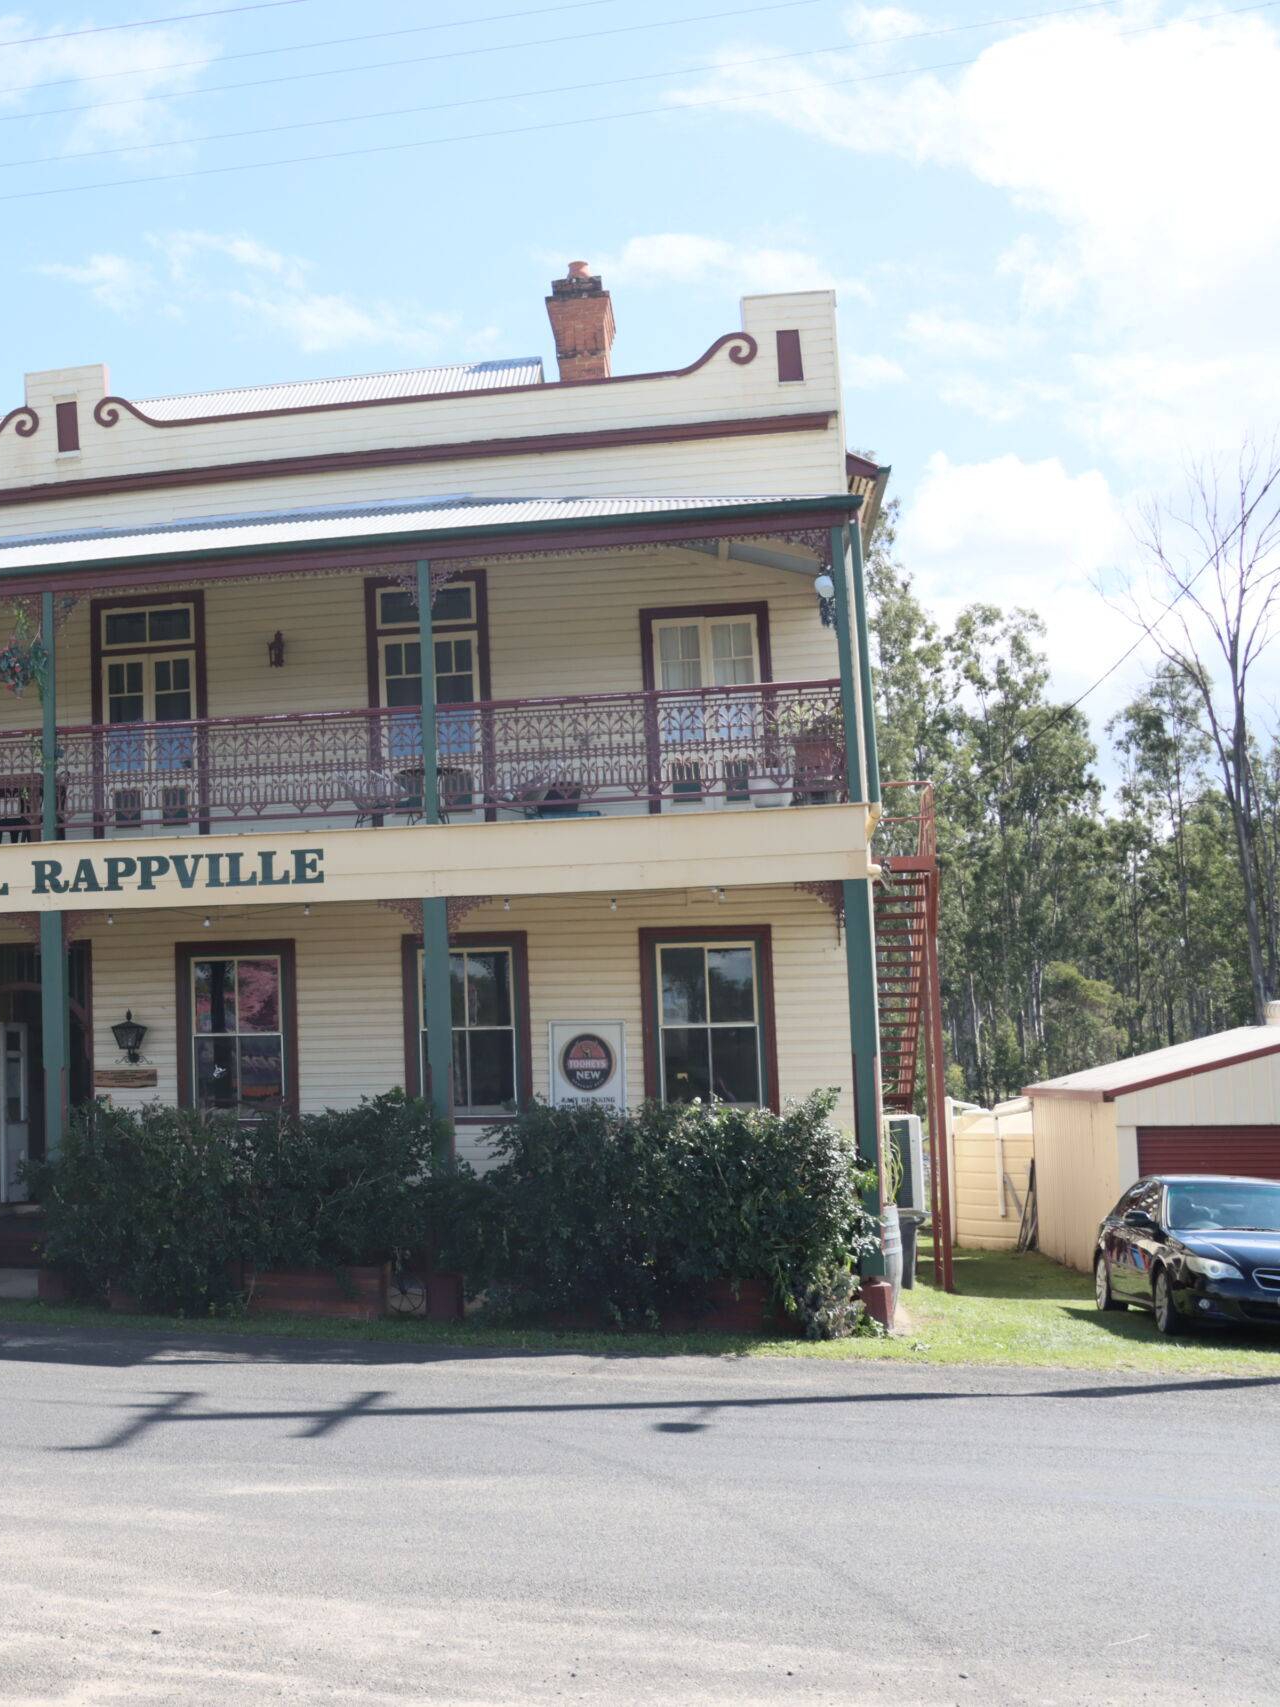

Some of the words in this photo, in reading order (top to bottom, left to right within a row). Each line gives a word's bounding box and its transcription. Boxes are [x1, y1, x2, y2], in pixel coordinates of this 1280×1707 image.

[31, 848, 325, 895] RAPPVILLE
[569, 1059, 607, 1069] TOOHEYS
[576, 1070, 601, 1080] NEW
